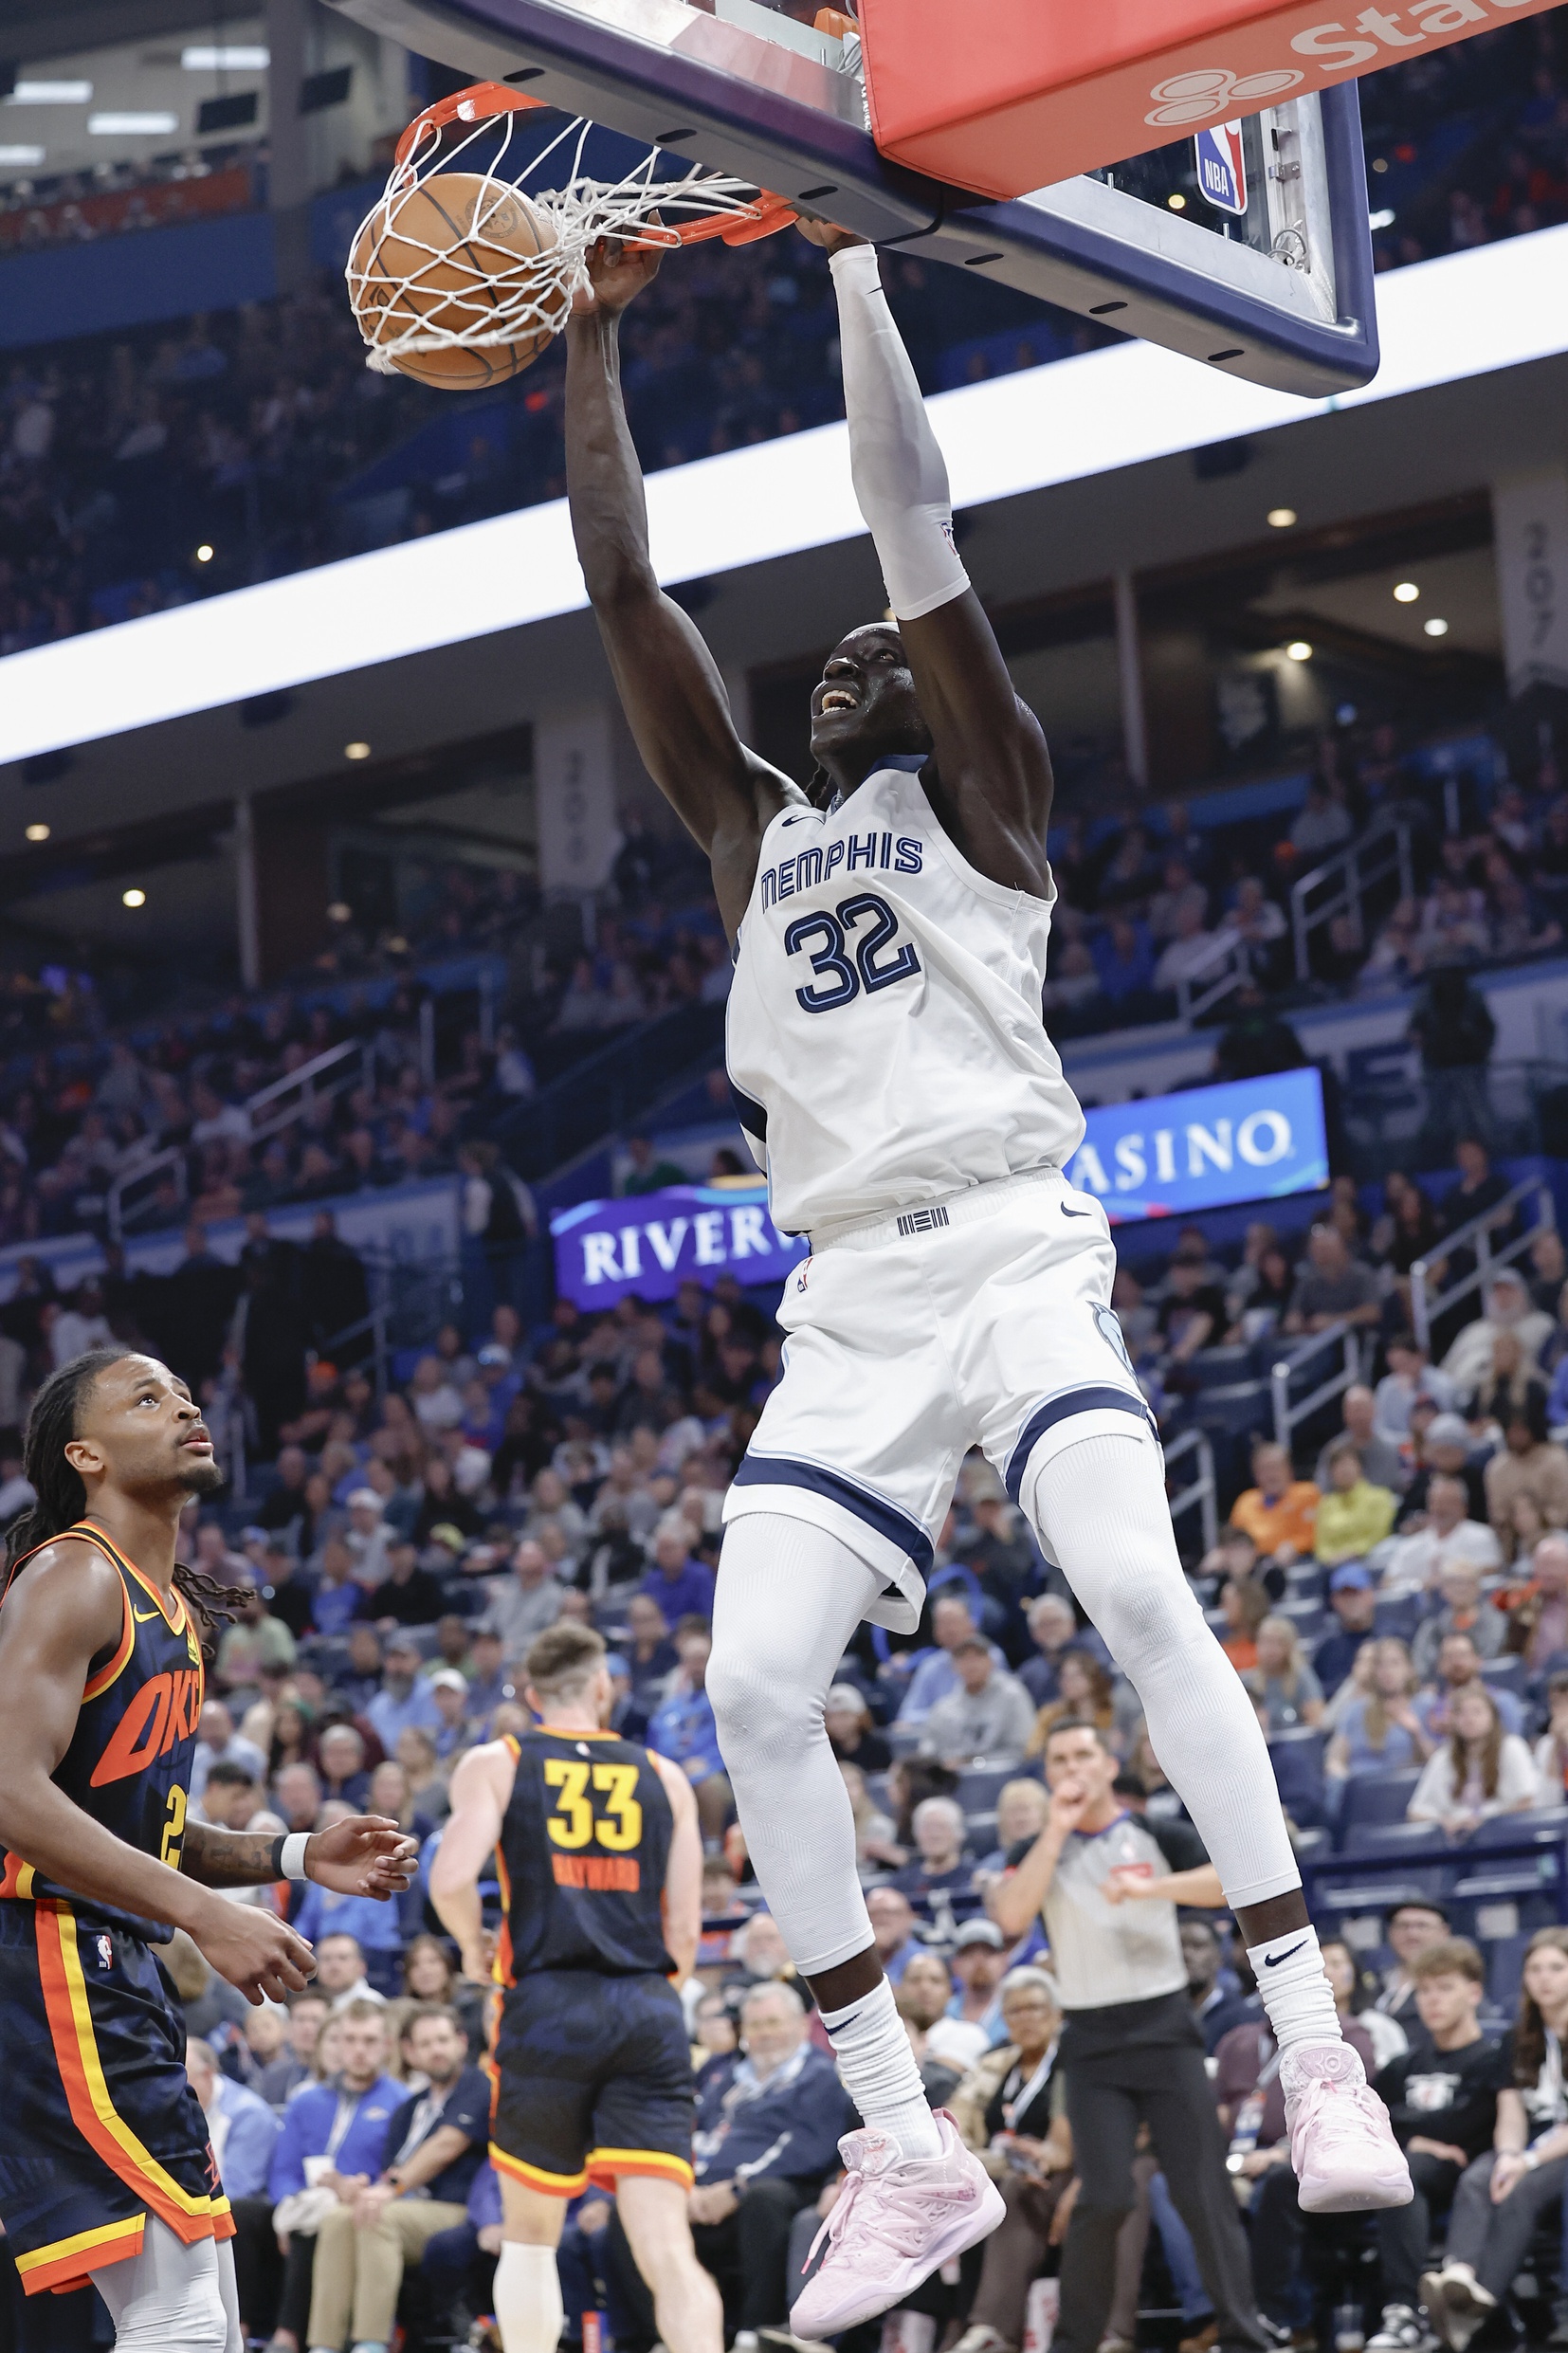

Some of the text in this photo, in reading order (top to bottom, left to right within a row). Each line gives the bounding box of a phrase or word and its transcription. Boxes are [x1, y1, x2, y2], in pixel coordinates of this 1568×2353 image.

[1290, 0, 1532, 70] Sta
[1204, 158, 1230, 197] NBA
[761, 831, 922, 914] MEMPHIS
[784, 893, 921, 1013] 32
[90, 1669, 200, 1787] OKC
[544, 1759, 643, 1851] 33
